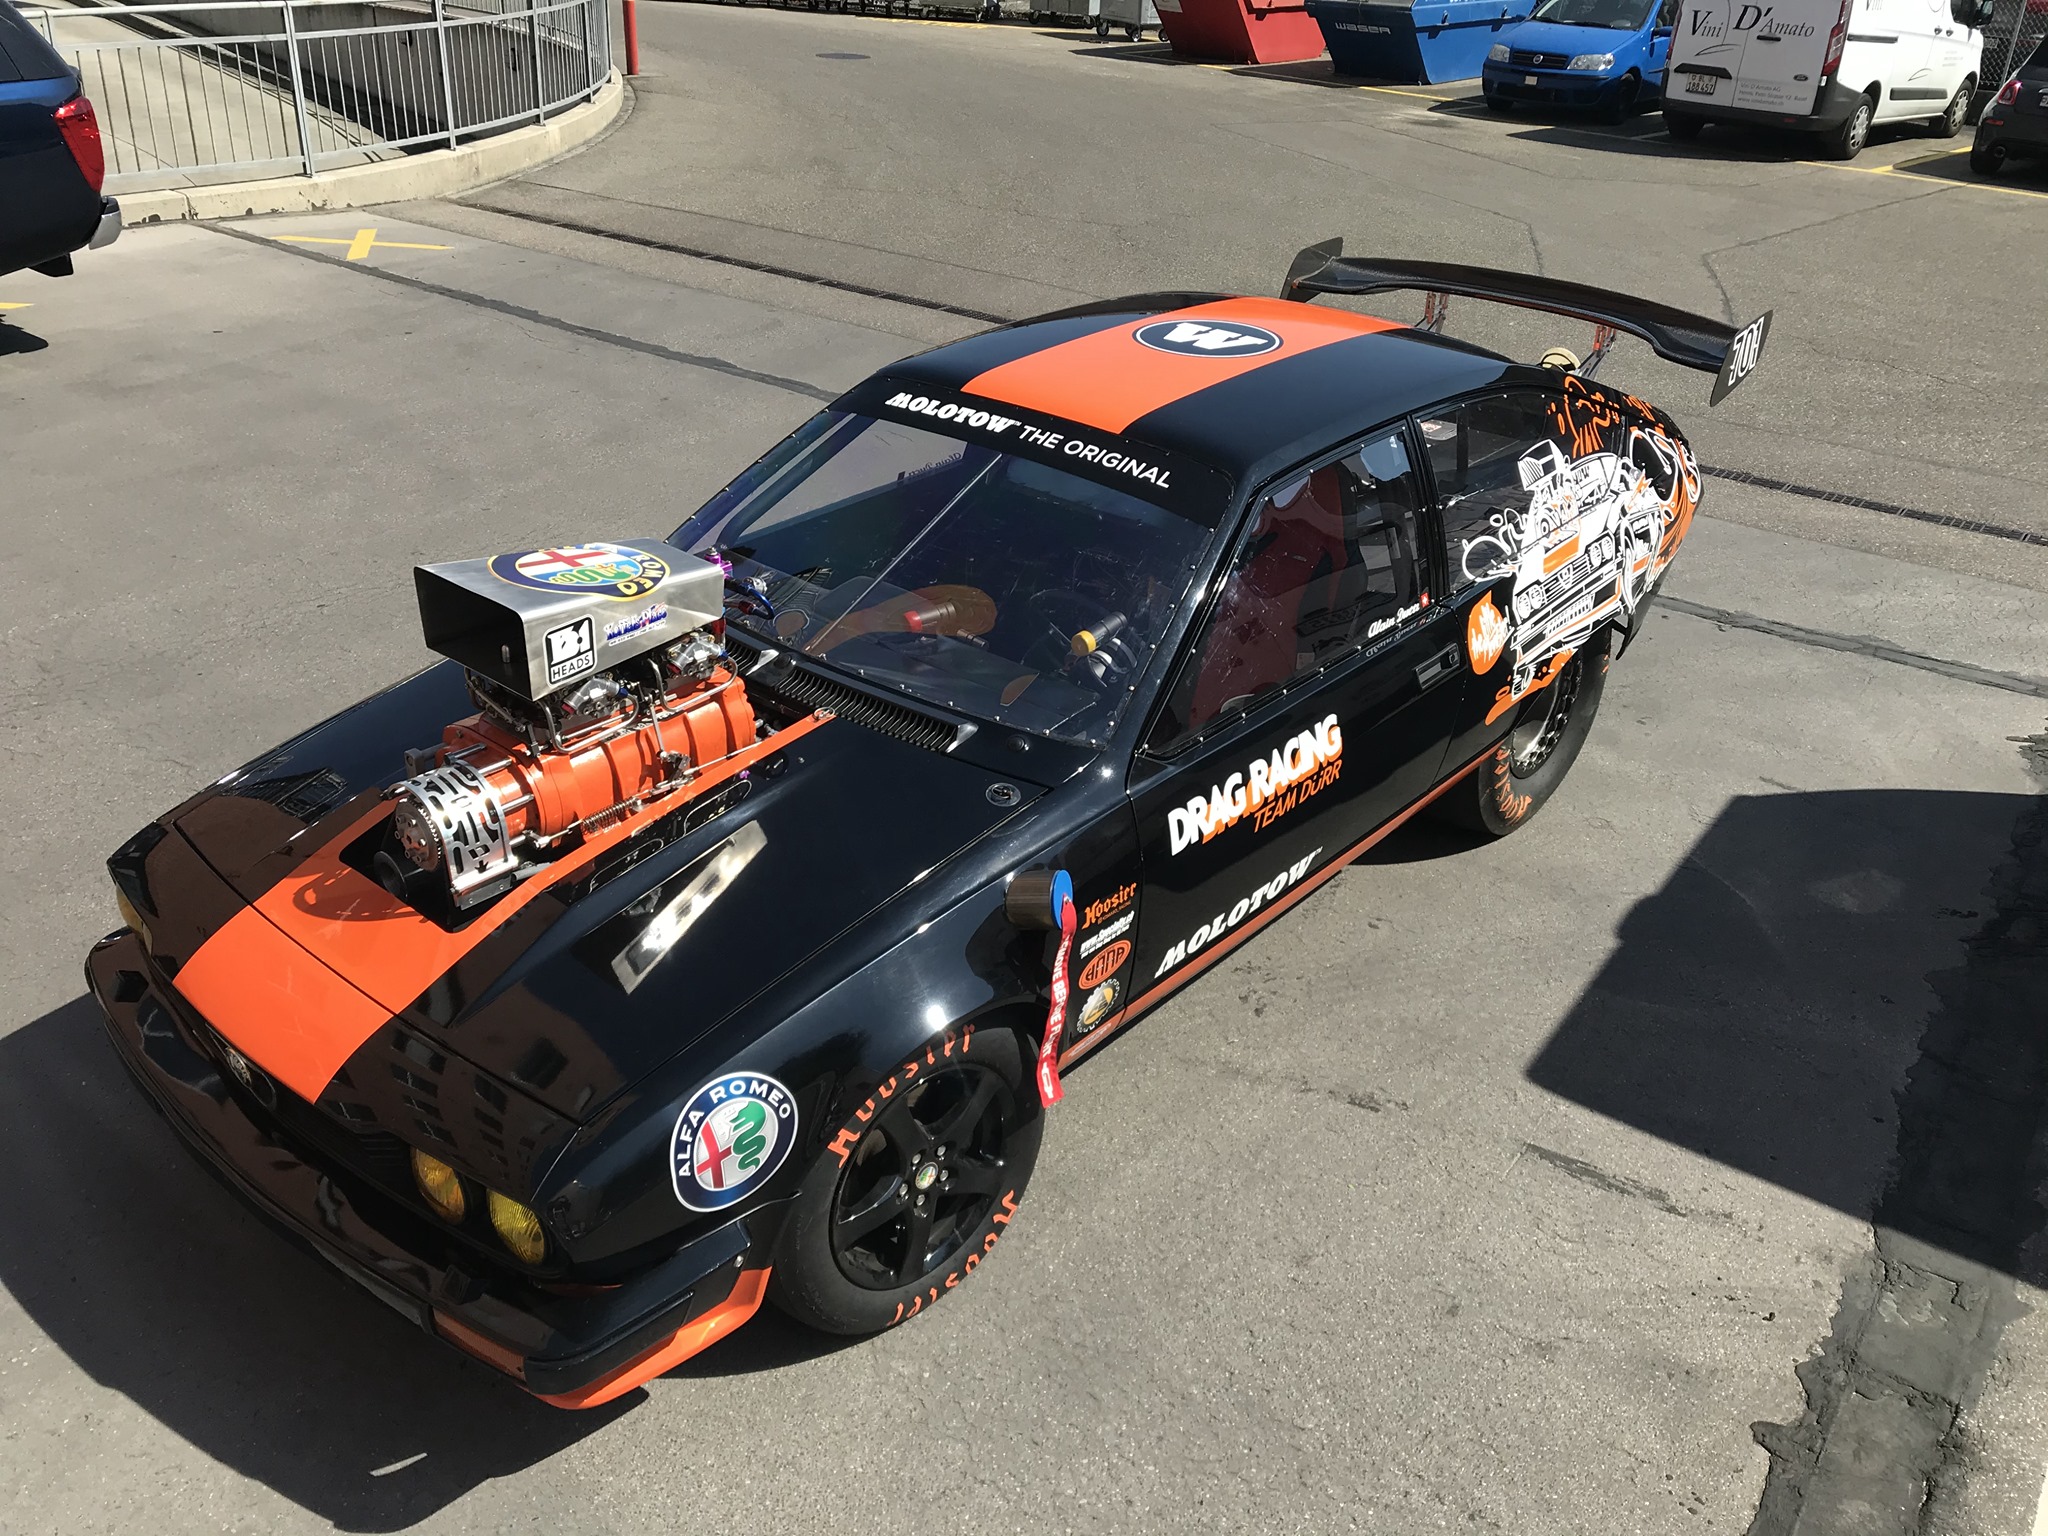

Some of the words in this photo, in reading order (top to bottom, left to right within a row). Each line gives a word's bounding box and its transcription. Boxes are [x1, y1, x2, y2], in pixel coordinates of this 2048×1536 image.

[1691, 10, 1724, 38] Vini
[1732, 4, 1815, 37] D'Amato
[1018, 424, 1065, 449] THE
[1063, 440, 1171, 489] ORIGINAL
[552, 654, 591, 679] HEADS
[1167, 772, 1248, 856] DRAG
[1249, 713, 1343, 807] RACING
[1254, 792, 1297, 833] TEAM
[1081, 882, 1137, 930] Hoosier
[1154, 848, 1319, 978] MOLOTOW
[677, 1110, 705, 1177] ALFA
[708, 1080, 791, 1119] ROMEO
